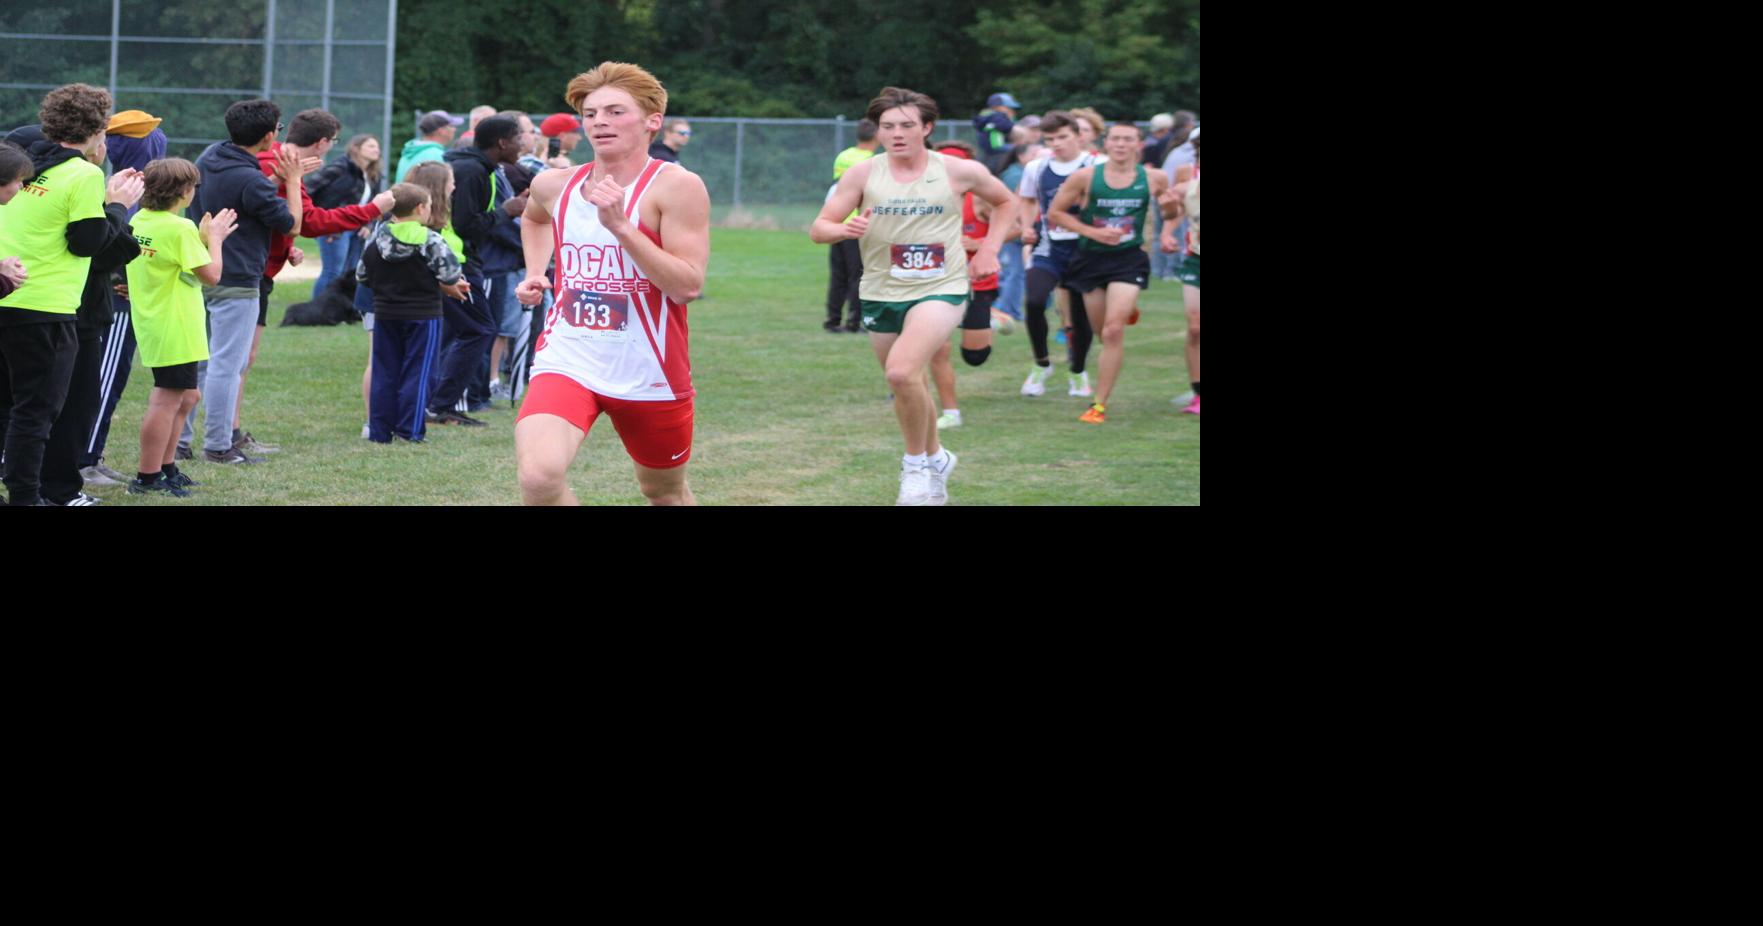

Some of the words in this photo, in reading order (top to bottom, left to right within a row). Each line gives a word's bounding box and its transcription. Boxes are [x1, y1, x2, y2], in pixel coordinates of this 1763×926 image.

[872, 206, 944, 216] JEFFERSON
[560, 243, 648, 281] OGAN
[902, 251, 935, 270] 384
[573, 301, 611, 328] 133
